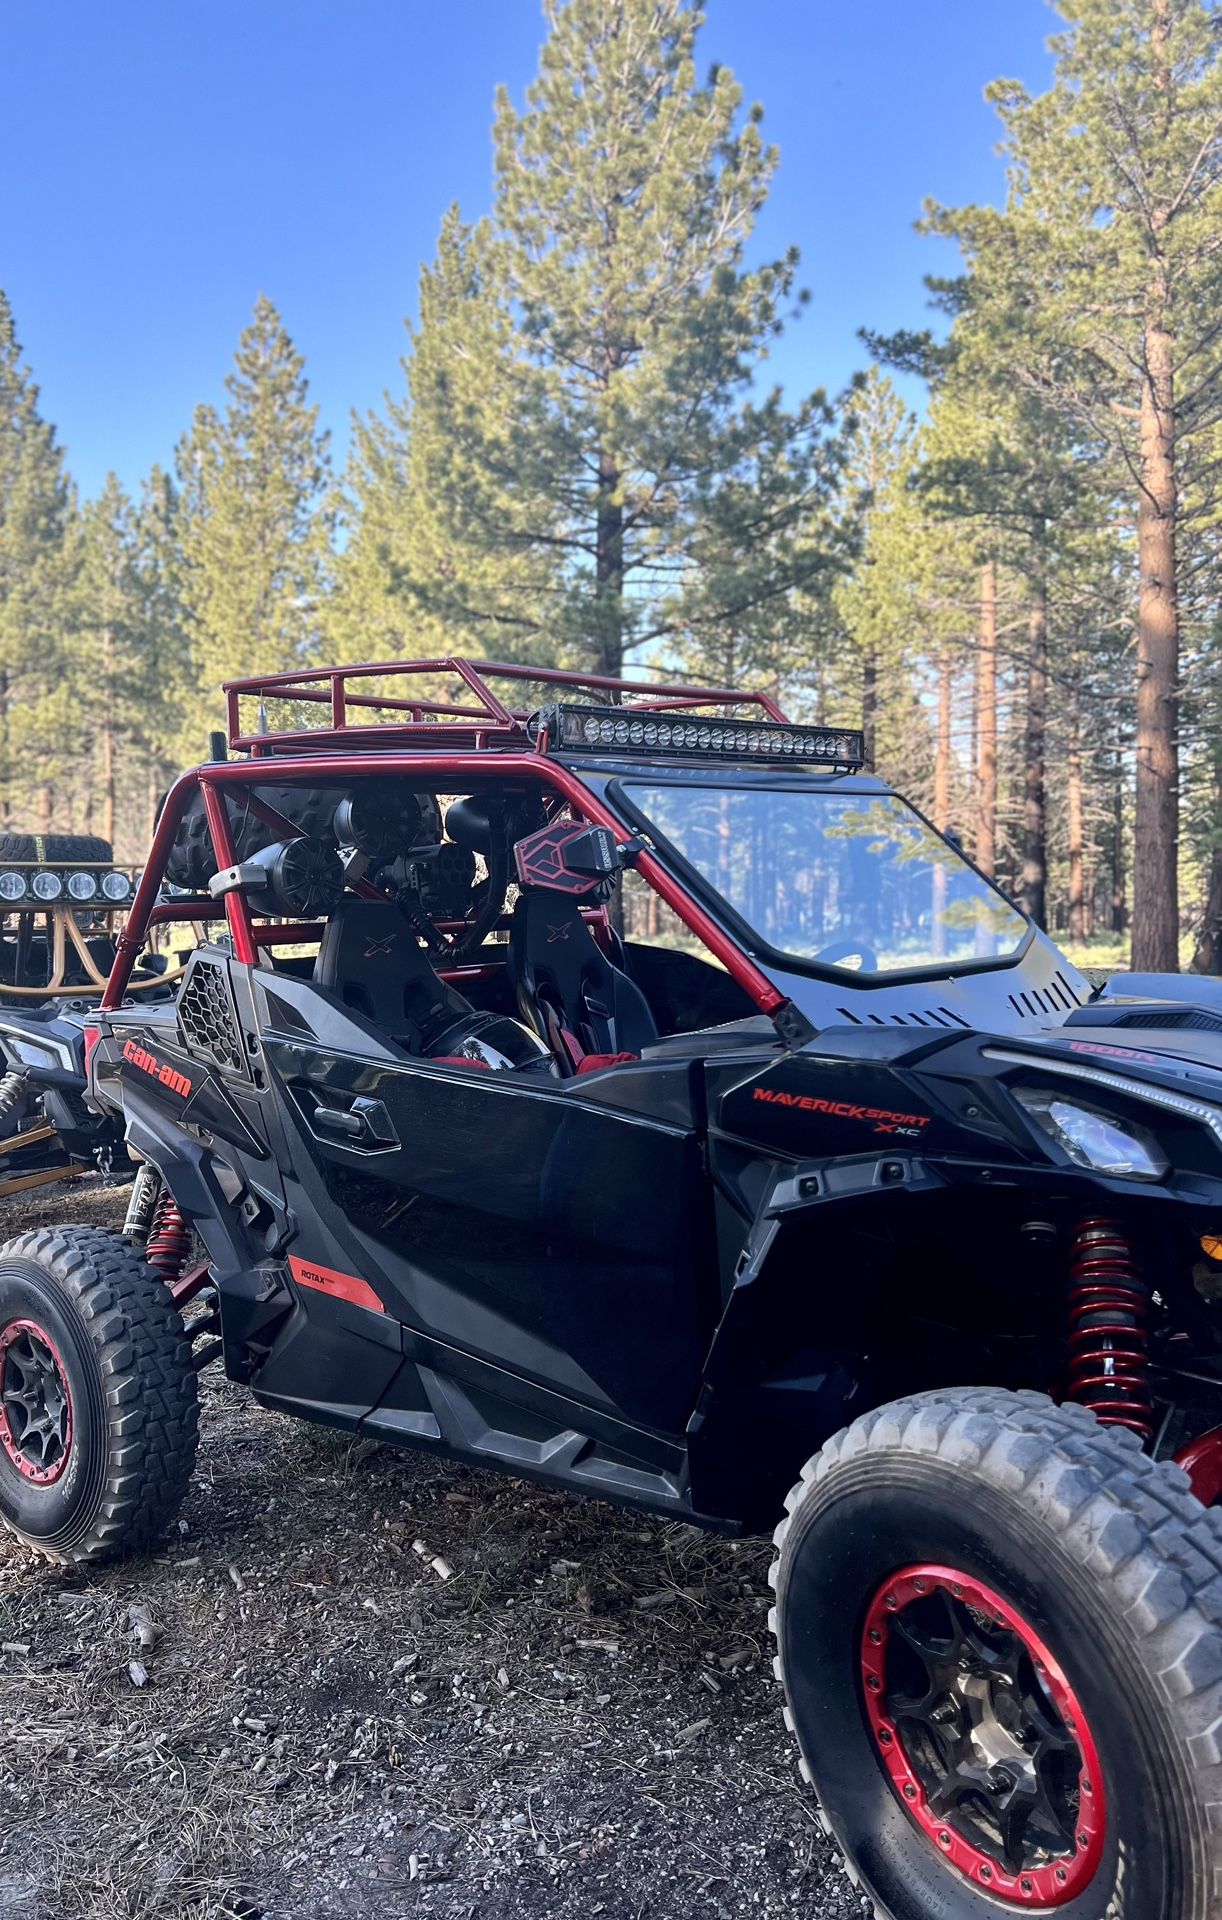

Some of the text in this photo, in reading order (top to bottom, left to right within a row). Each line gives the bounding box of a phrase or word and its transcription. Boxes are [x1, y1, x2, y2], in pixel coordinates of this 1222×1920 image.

[753, 1088, 866, 1119] MAVERICK
[134, 1173, 159, 1217] FOX
[301, 1269, 325, 1285] ROTAX
